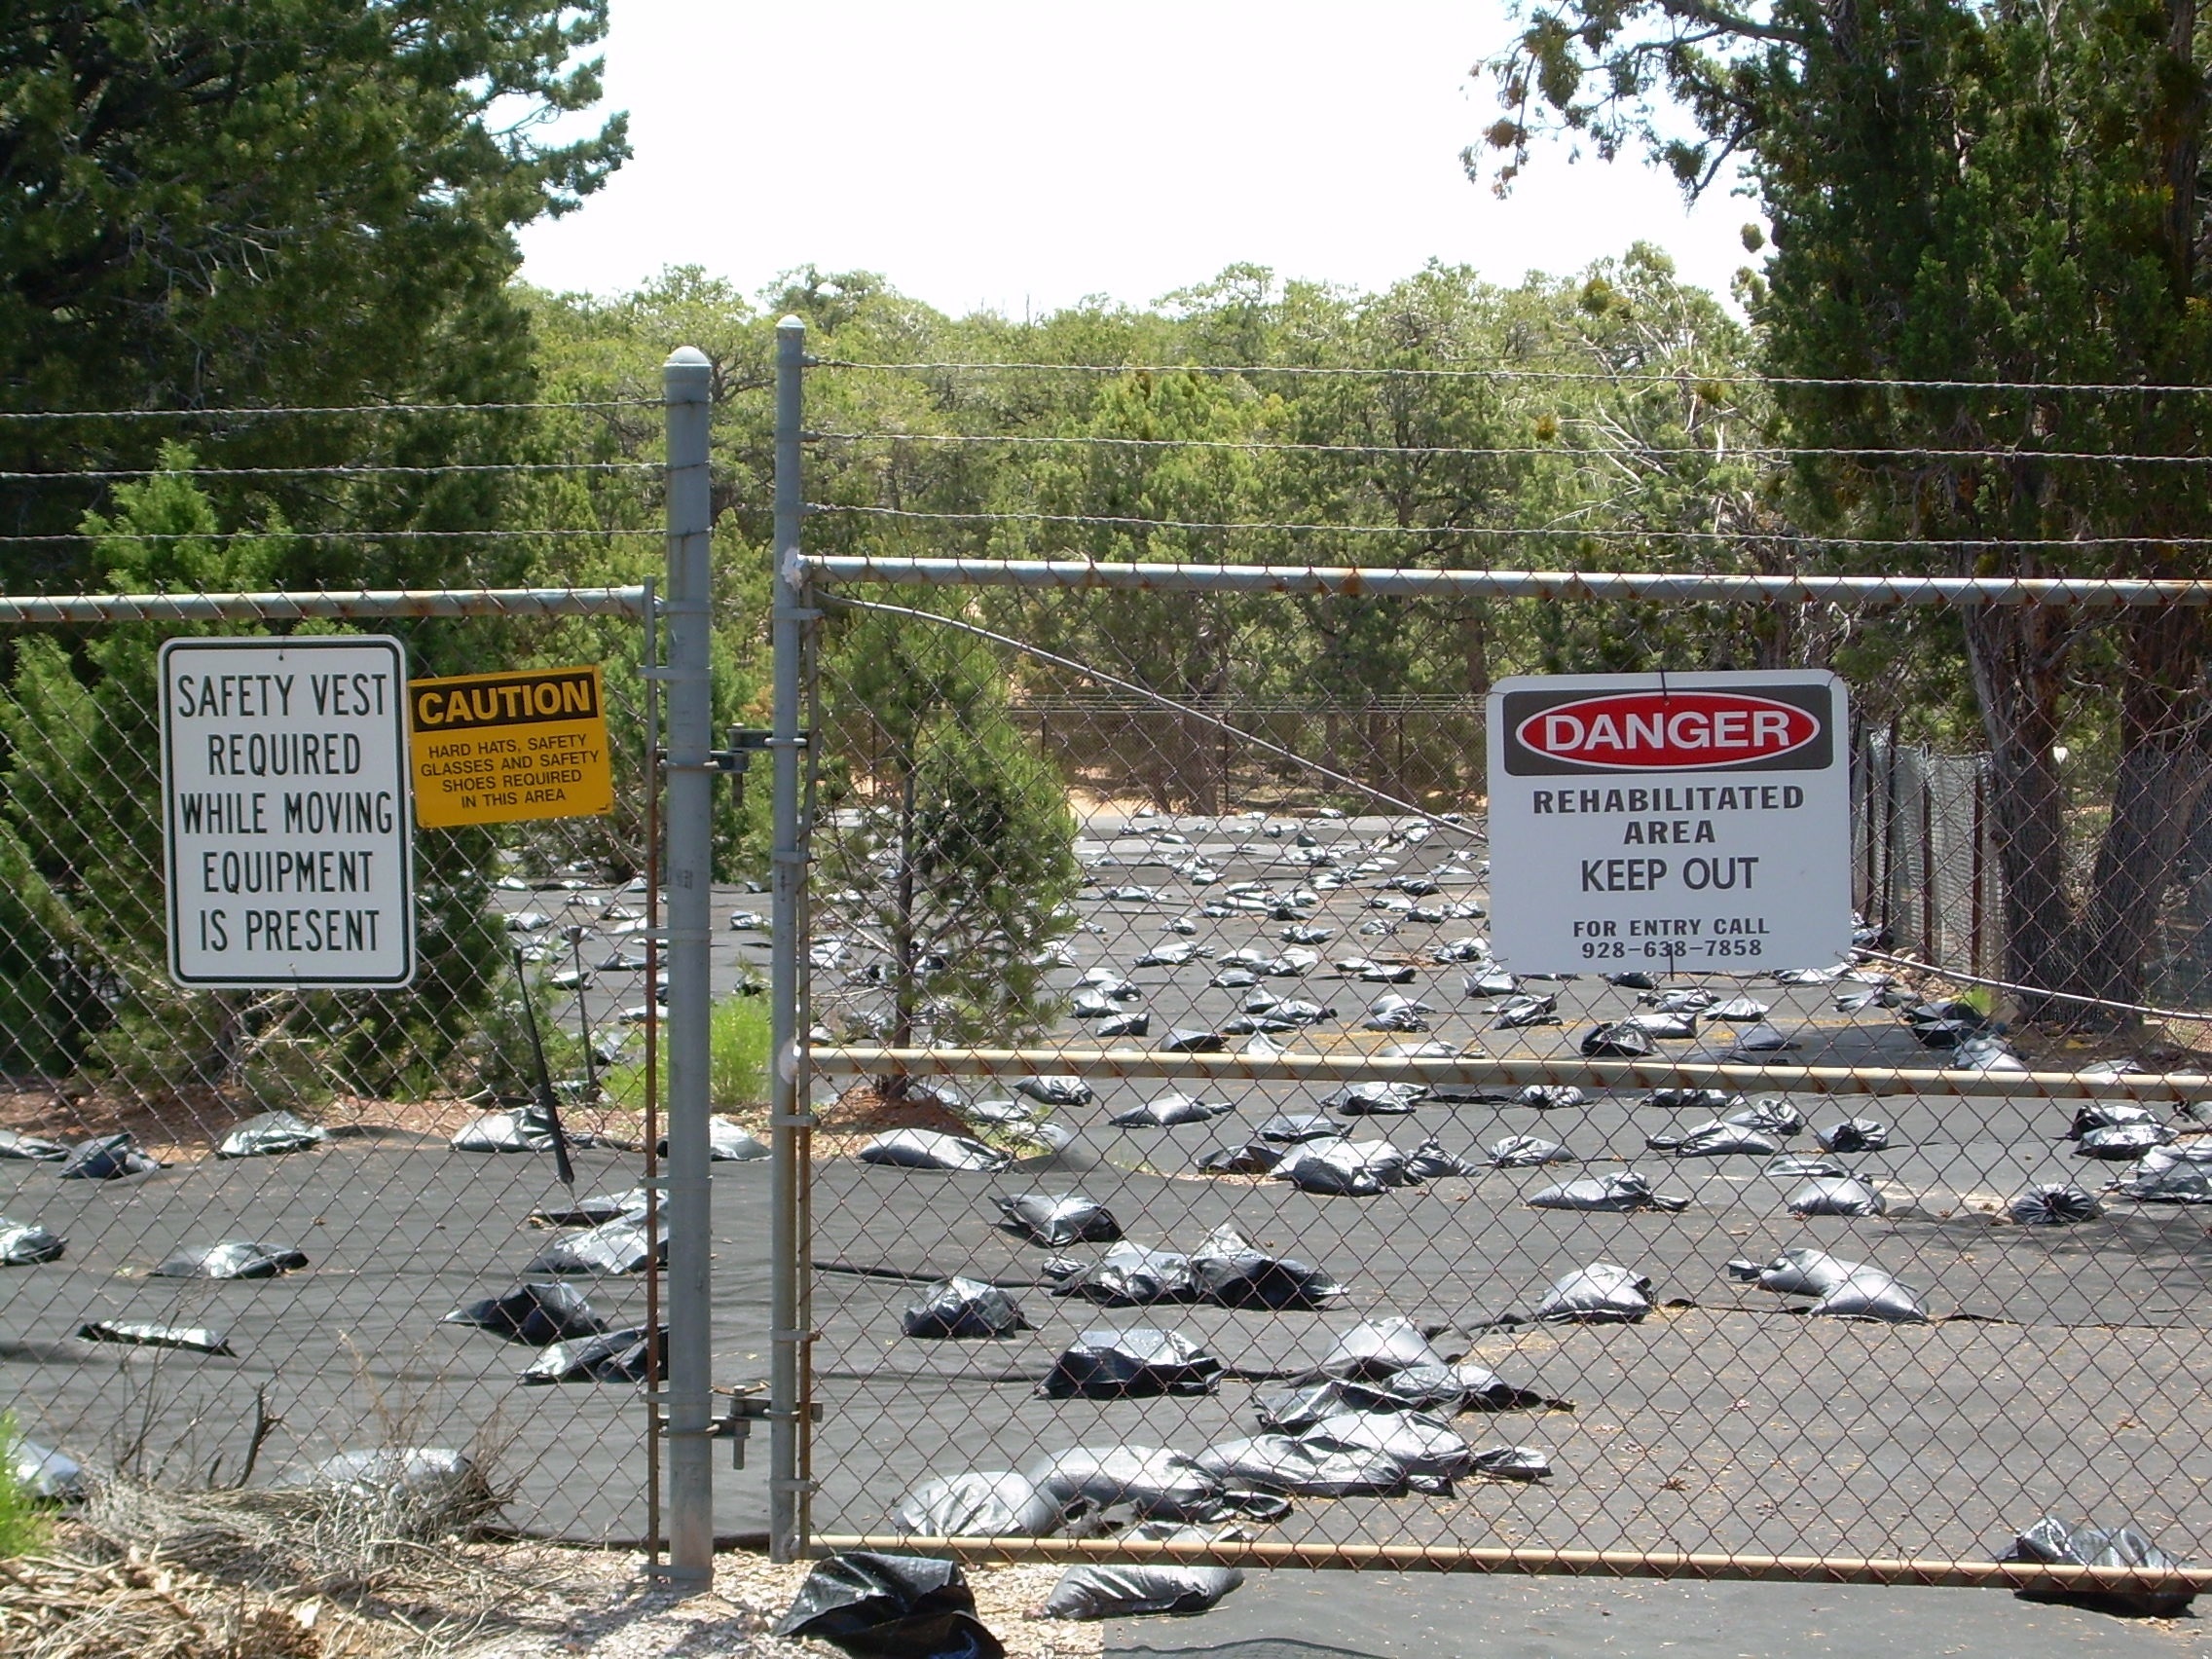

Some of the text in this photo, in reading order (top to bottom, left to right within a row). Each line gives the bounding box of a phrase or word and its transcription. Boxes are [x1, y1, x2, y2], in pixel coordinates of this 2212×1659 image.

[177, 673, 387, 718] SAFETY VEST
[418, 680, 591, 724] CAUTION
[428, 743, 471, 758] HARD
[528, 733, 587, 751] SAFETY
[1544, 710, 1791, 752] DANGER
[207, 733, 361, 777] REQUIRED
[421, 750, 600, 777] GLASSES AND SAFETY
[442, 769, 582, 793] SHOES REQUIRED
[180, 791, 393, 834] WHILE MOVING
[461, 789, 567, 809] IN THIS AREA
[1532, 785, 1805, 814] REHABILITATED
[1623, 819, 1716, 845] AREA
[203, 850, 374, 895] EQUIPMENT
[1581, 857, 1759, 892] KEEP OUT
[200, 908, 380, 952] IS PRESENT
[1573, 917, 1771, 938] FOR ENTRY CALL
[1581, 939, 1763, 959] 928-638-7858
